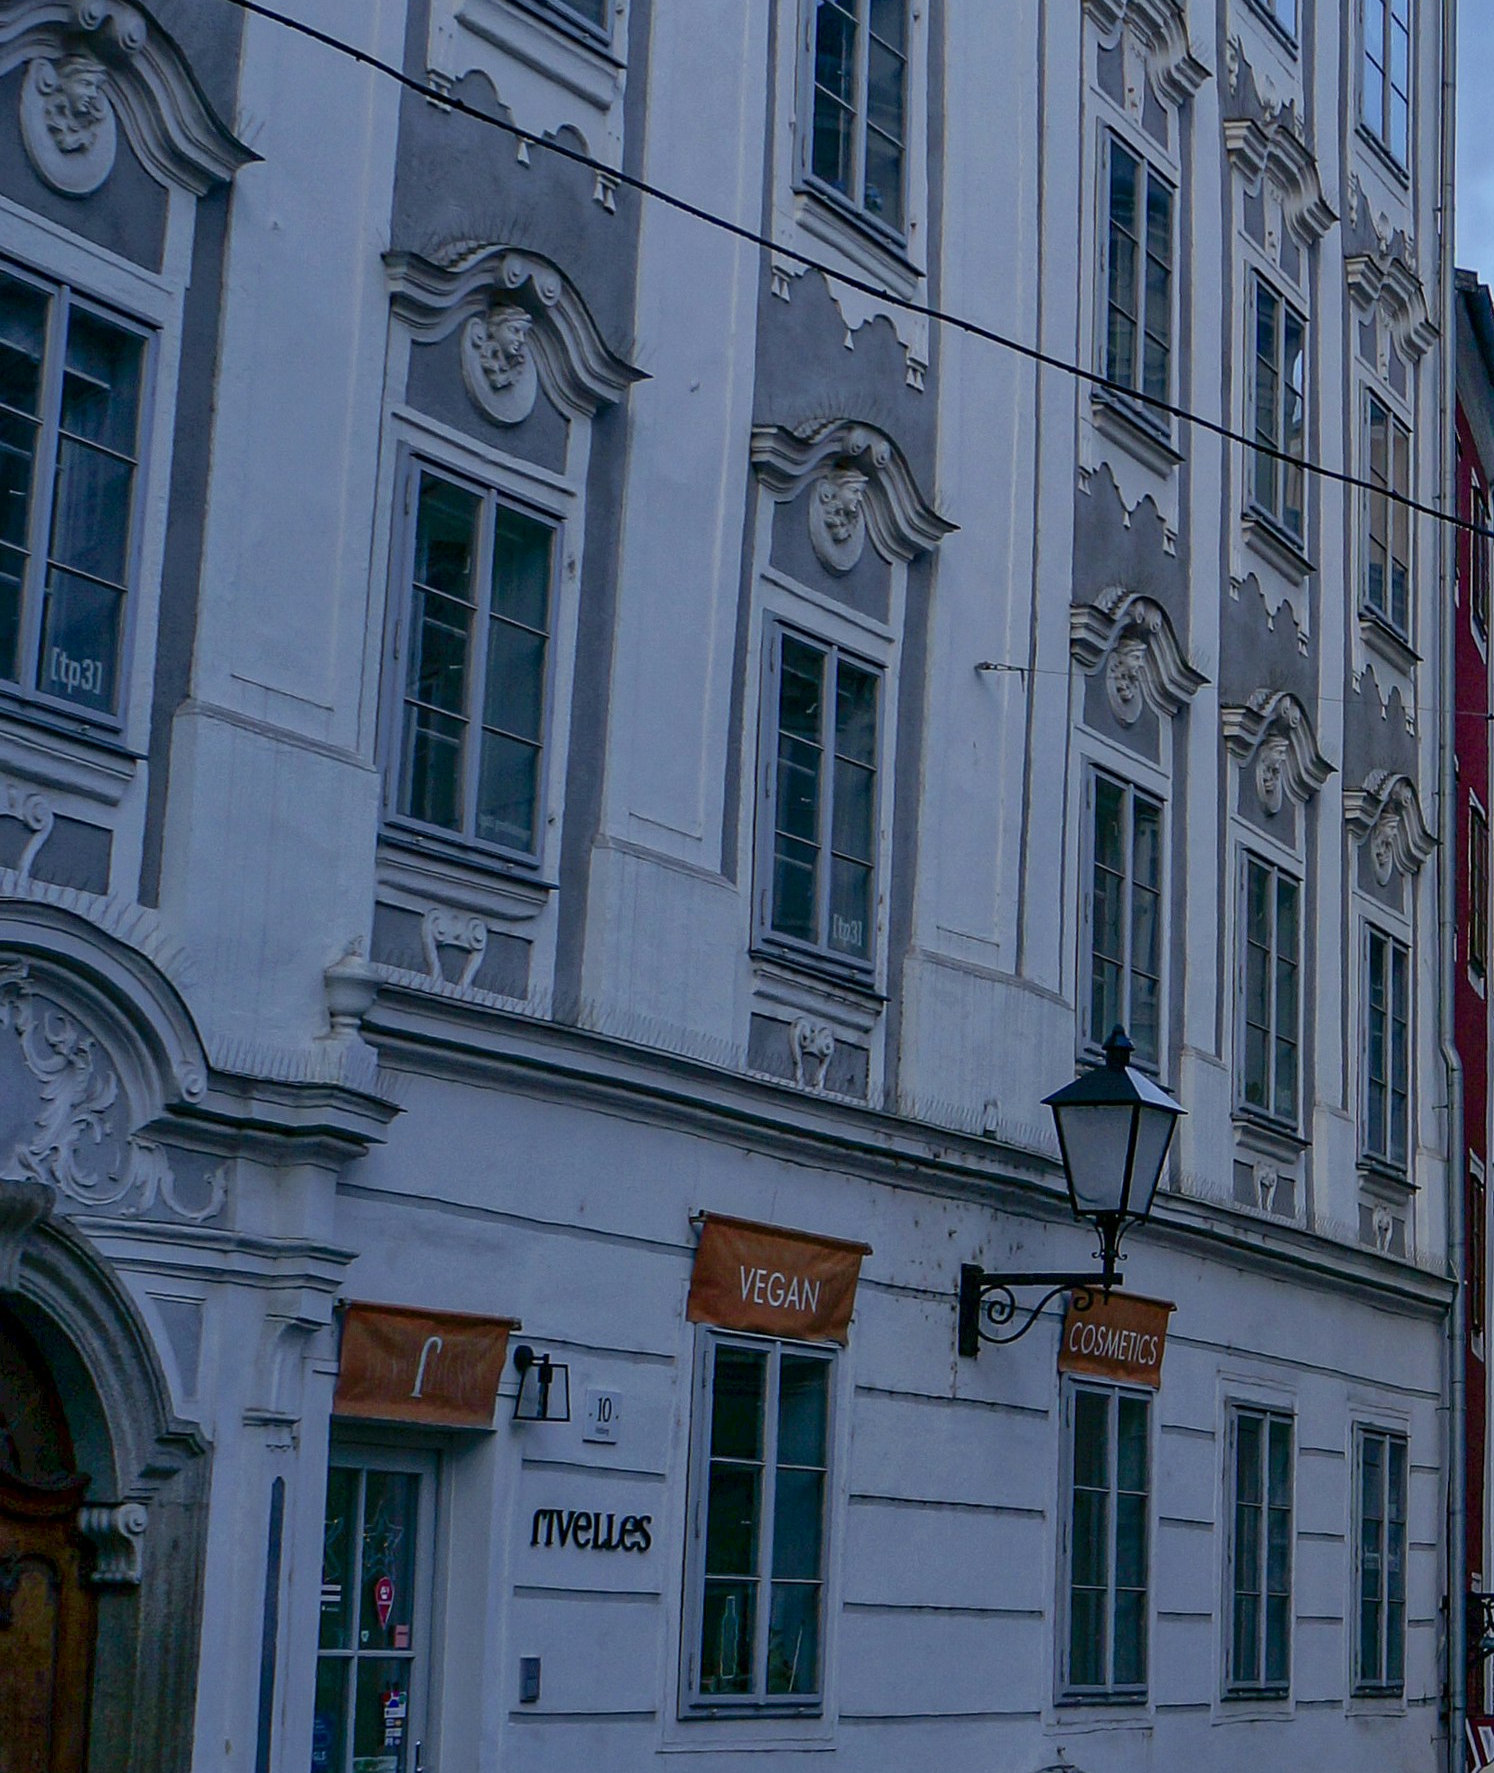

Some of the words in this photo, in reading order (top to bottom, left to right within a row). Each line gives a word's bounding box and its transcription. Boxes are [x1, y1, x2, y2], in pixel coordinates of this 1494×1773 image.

[50, 646, 103, 695] [tp3]
[739, 1264, 822, 1316] VEGAN
[1069, 1321, 1159, 1366] COSMETICS
[597, 1396, 613, 1424] 10
